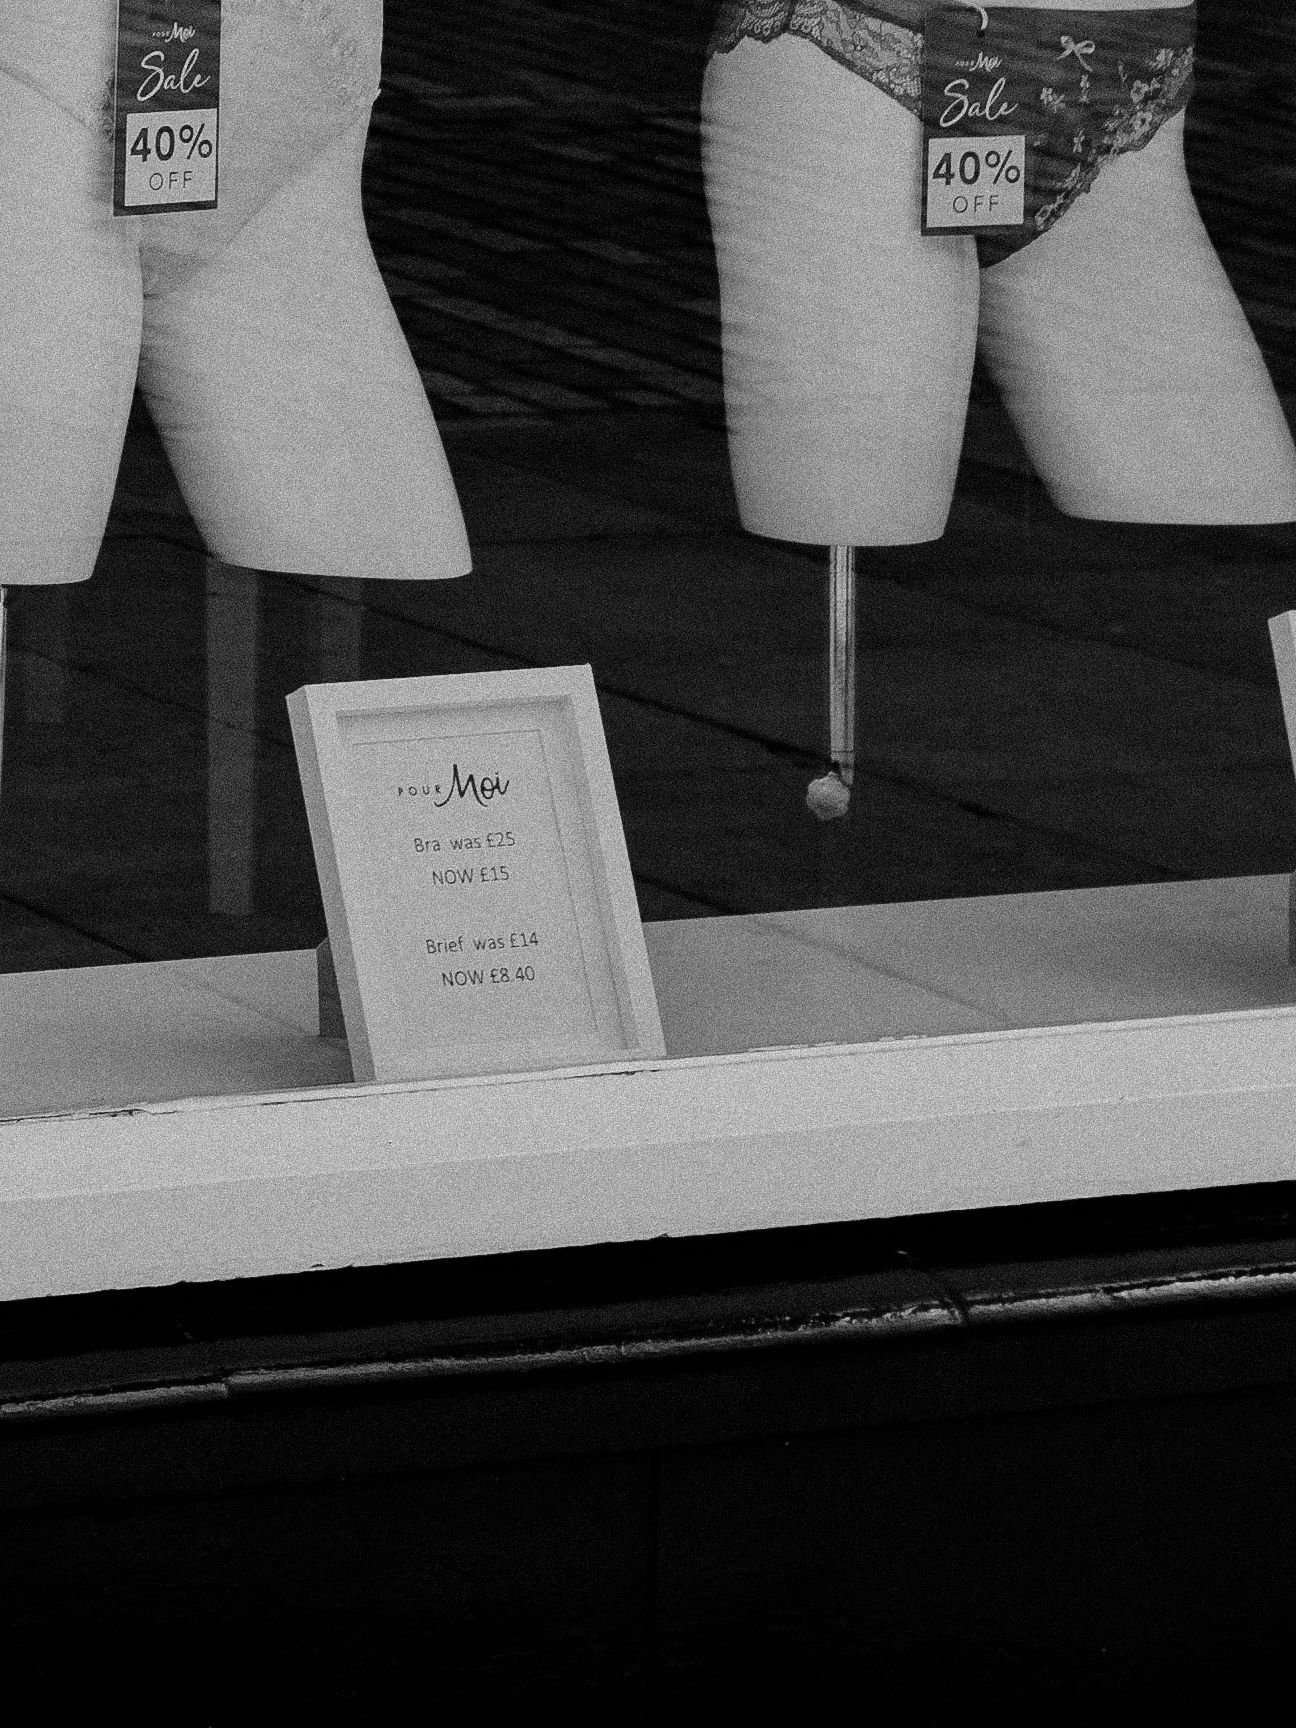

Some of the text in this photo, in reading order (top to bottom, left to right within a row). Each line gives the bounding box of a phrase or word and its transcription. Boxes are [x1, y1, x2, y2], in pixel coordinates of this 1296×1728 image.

[136, 48, 211, 102] Sale
[939, 76, 1019, 128] Sale
[130, 123, 213, 162] 40%
[932, 149, 1021, 186] 40%
[149, 171, 193, 191] OFF
[952, 195, 999, 214] OFF
[434, 764, 510, 808] Moi
[414, 831, 516, 852] Bra was £25
[432, 865, 509, 885] NOW £15
[425, 932, 539, 955] Brief was £14
[442, 970, 485, 987] NOW
